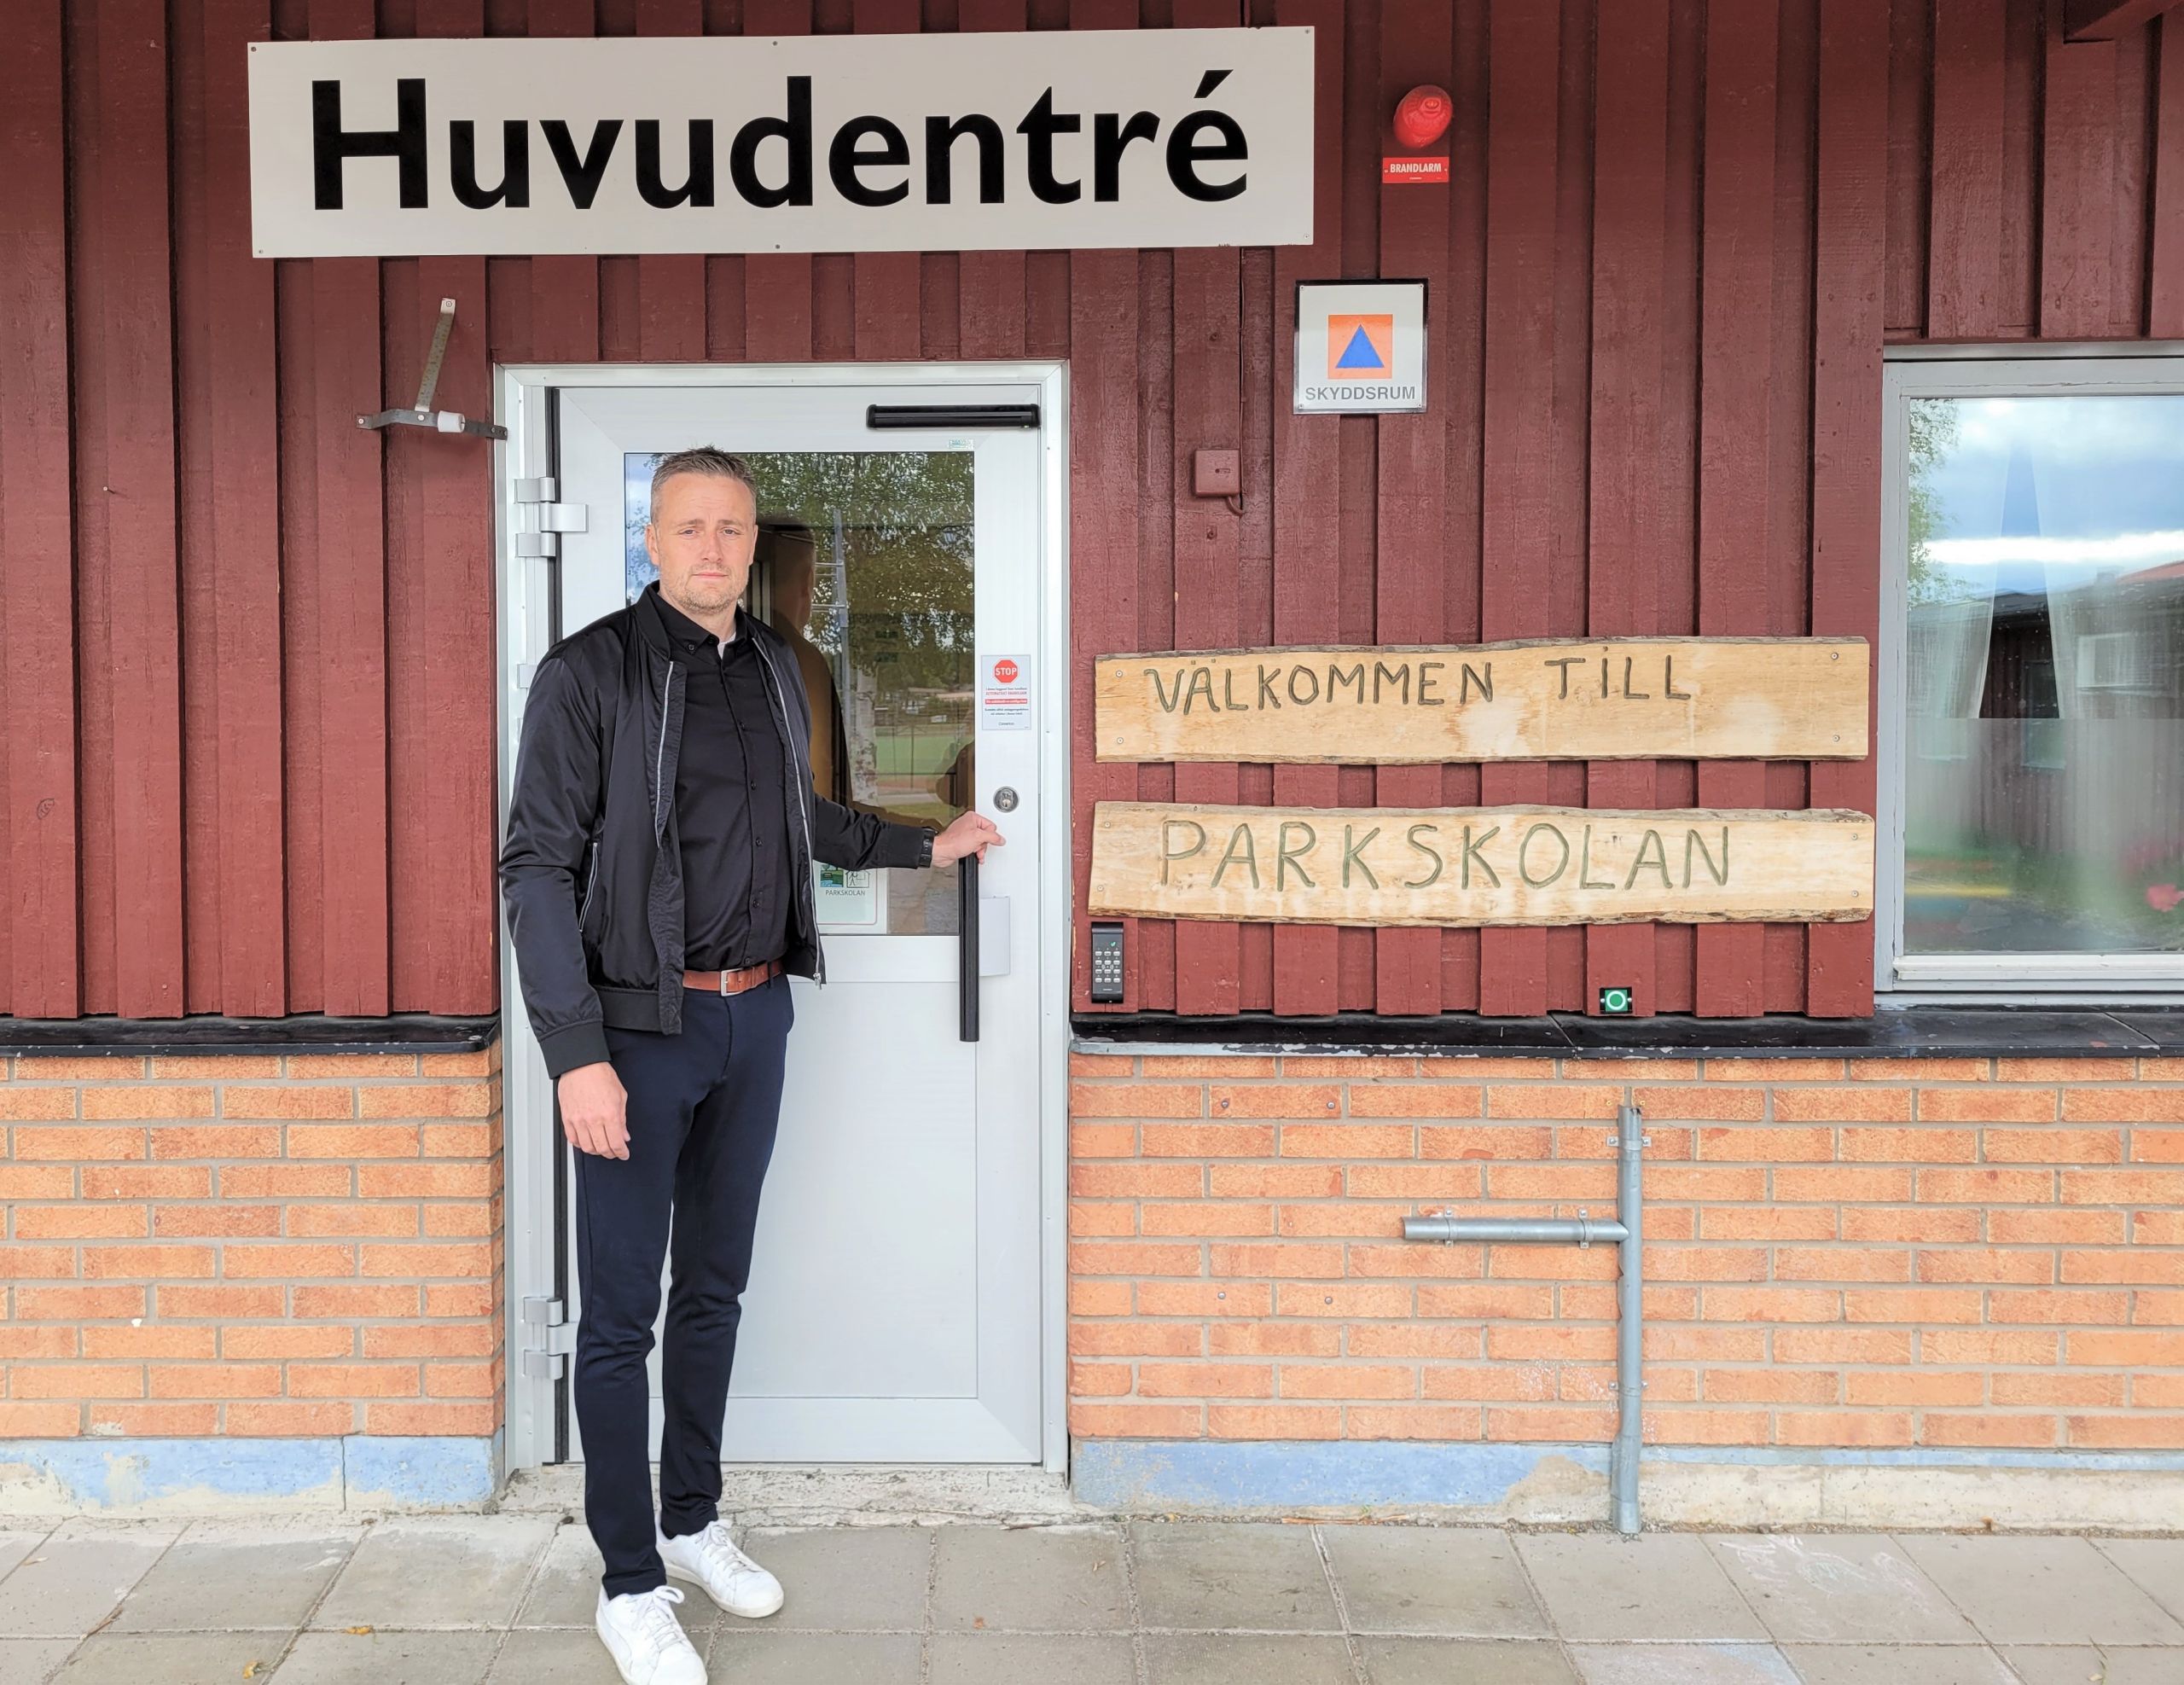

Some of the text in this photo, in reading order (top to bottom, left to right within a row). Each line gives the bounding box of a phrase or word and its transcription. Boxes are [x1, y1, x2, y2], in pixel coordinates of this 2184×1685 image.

[311, 68, 1249, 210] Huvudentré
[1390, 163, 1442, 173] BRANDLARM
[1305, 386, 1415, 400] SKYDDSRUM
[995, 667, 1017, 676] STOP
[1143, 658, 1494, 715] VÄLKOMMEN
[1160, 820, 1728, 892] PARKSKOLAN
